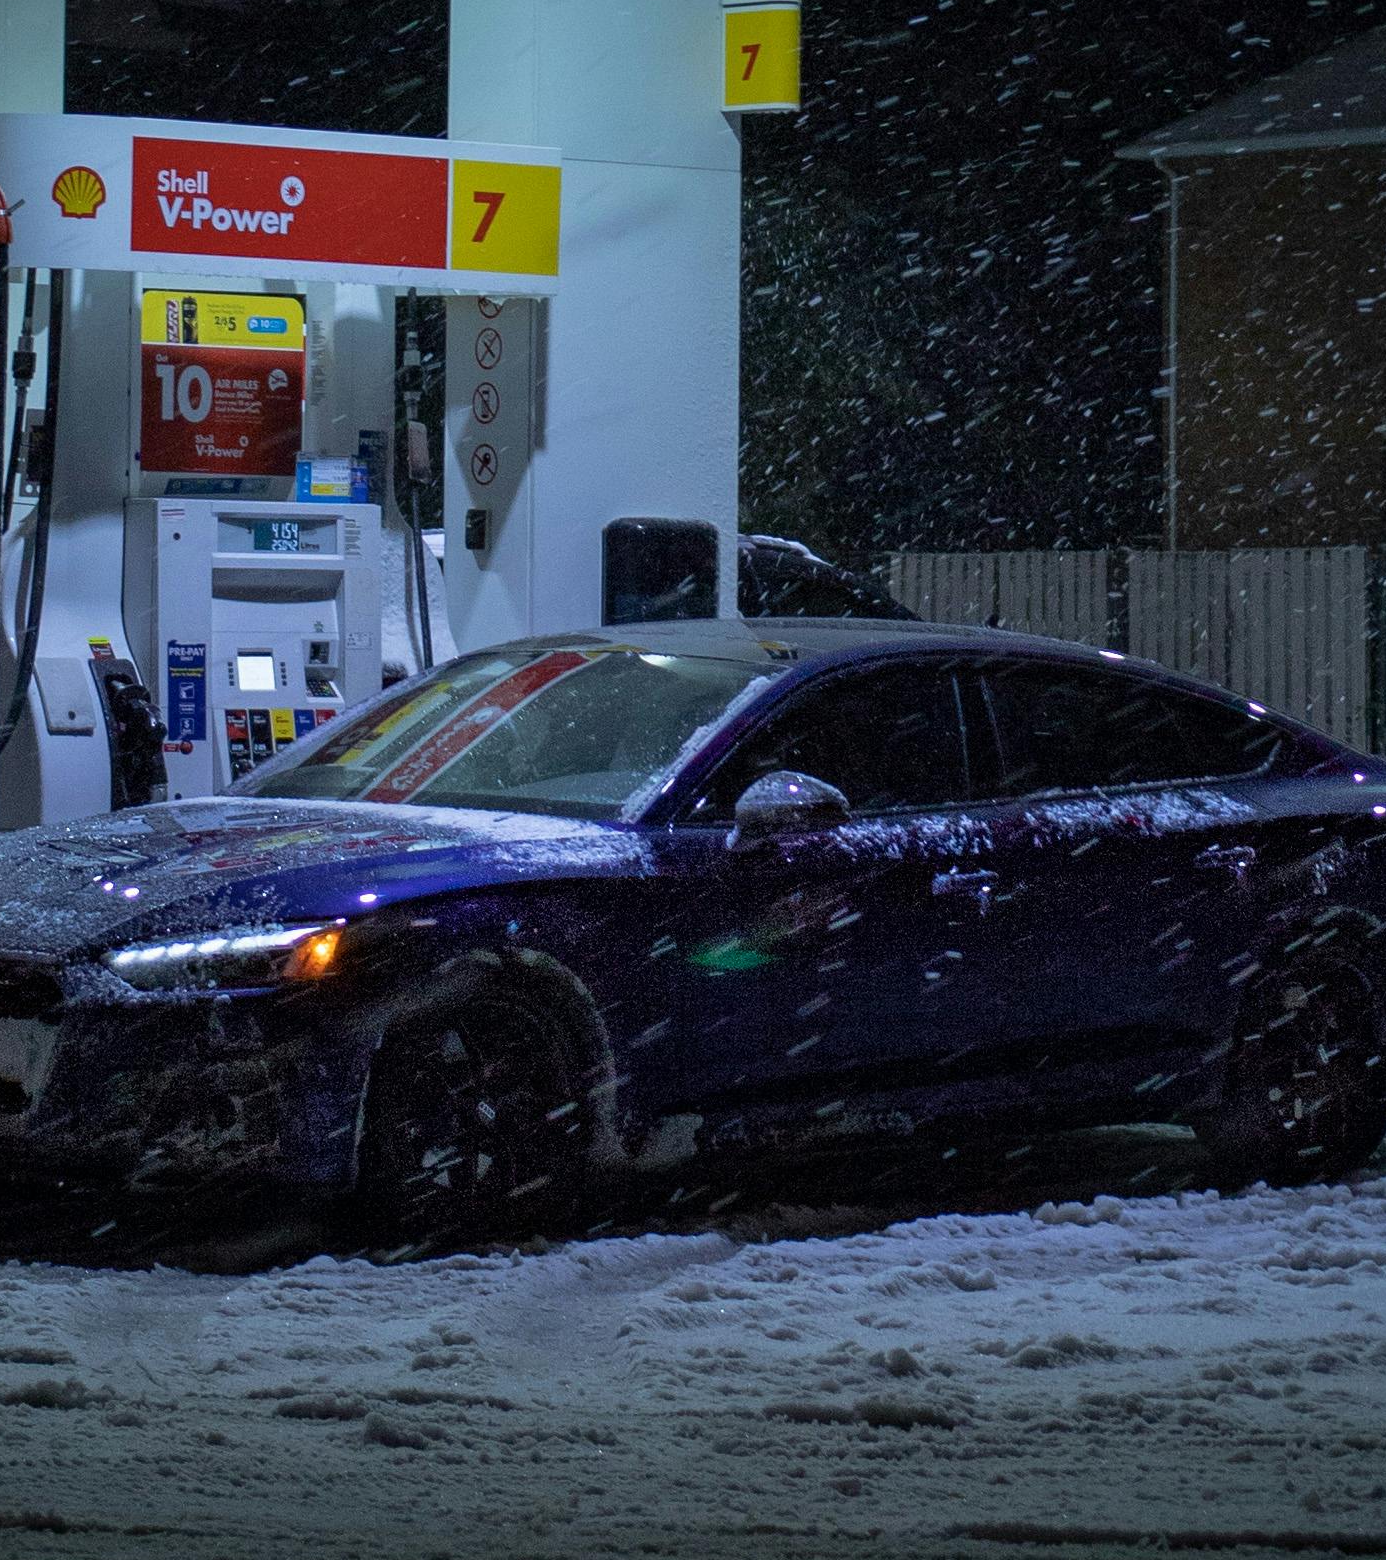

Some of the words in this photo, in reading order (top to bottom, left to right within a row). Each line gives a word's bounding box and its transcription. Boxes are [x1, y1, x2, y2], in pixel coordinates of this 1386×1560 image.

[741, 43, 762, 81] 7
[157, 169, 209, 195] Shell
[157, 195, 294, 236] V-Power
[472, 191, 505, 243] 7
[155, 364, 213, 423] 10
[196, 444, 246, 458] V-Power
[169, 647, 205, 656] PRE-PAY
